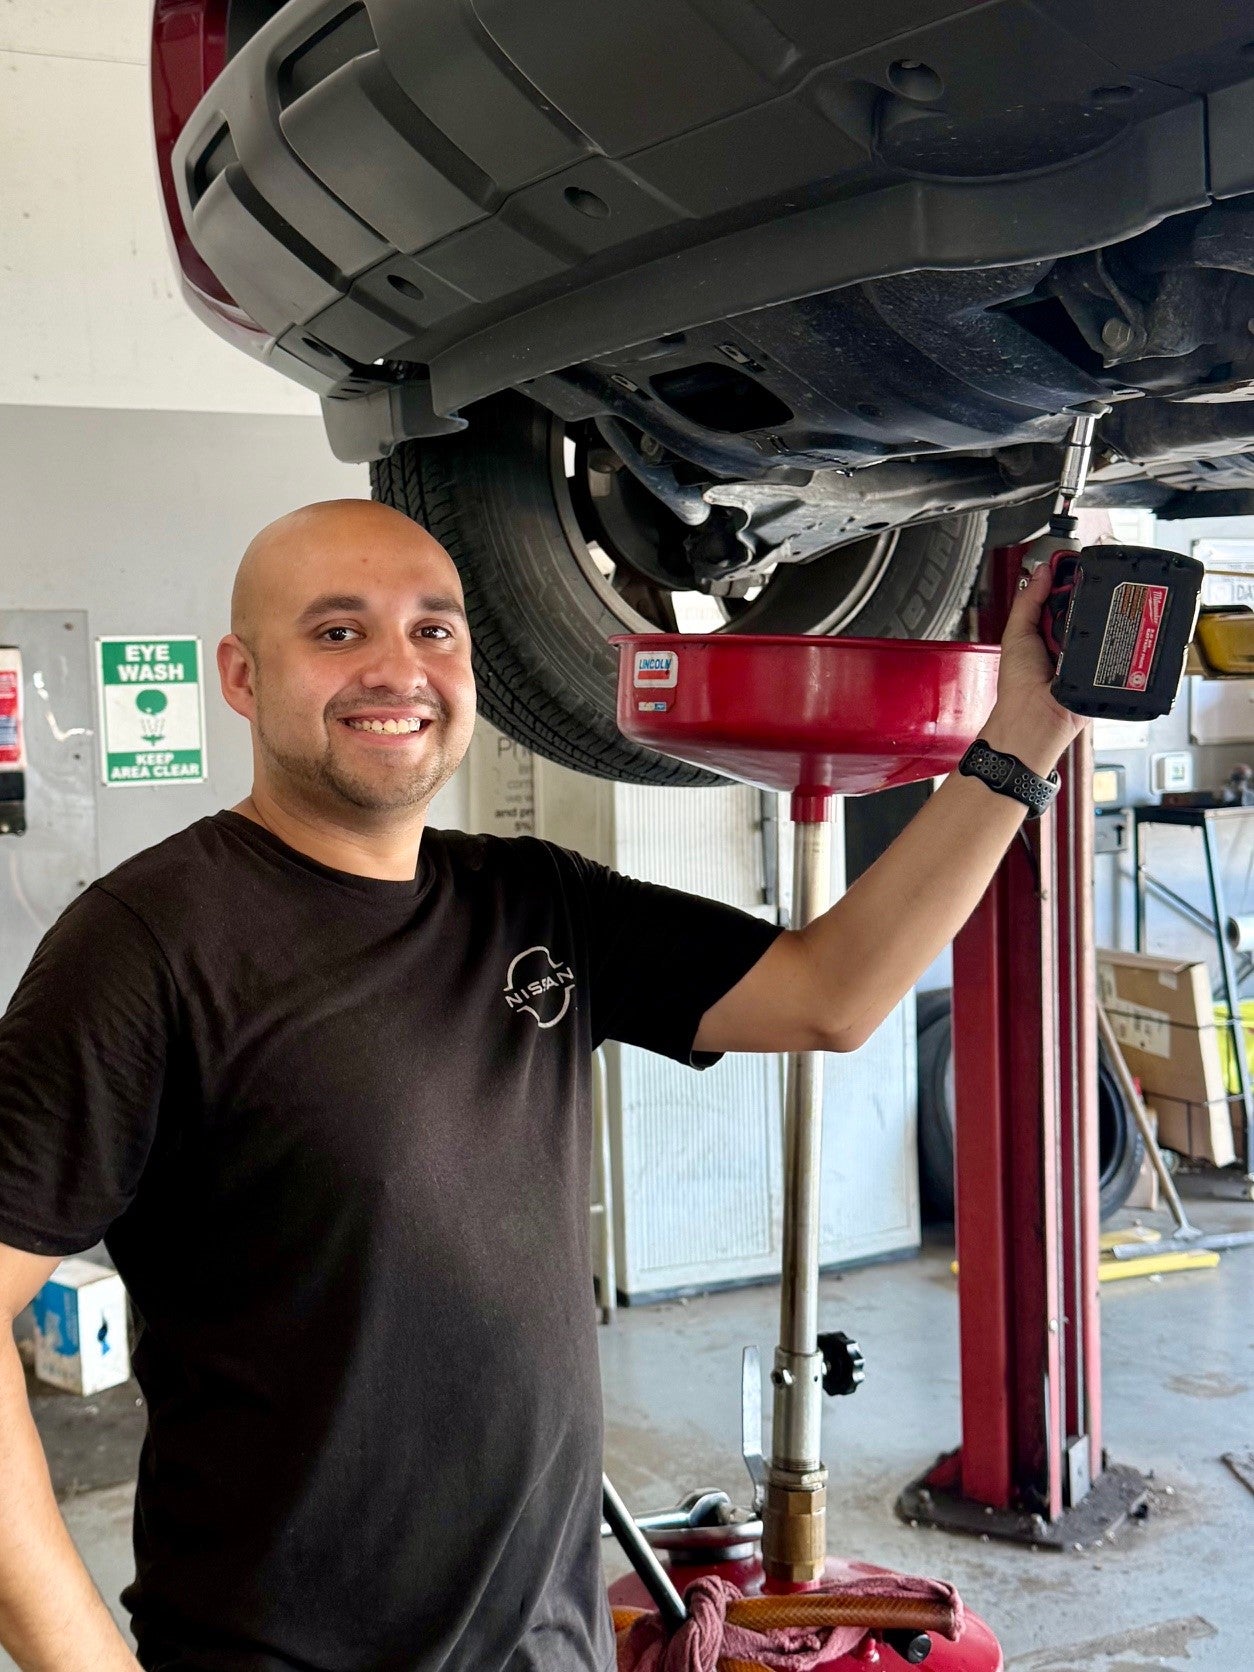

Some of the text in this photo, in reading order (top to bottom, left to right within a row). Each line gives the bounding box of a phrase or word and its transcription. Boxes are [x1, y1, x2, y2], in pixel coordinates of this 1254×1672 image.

[125, 644, 170, 662] EYE
[117, 663, 184, 681] WASH
[639, 659, 671, 669] LINCOLN
[135, 752, 174, 765] KEEP
[111, 763, 200, 779] AREA CLEAR
[505, 967, 574, 1008] NISSAN
